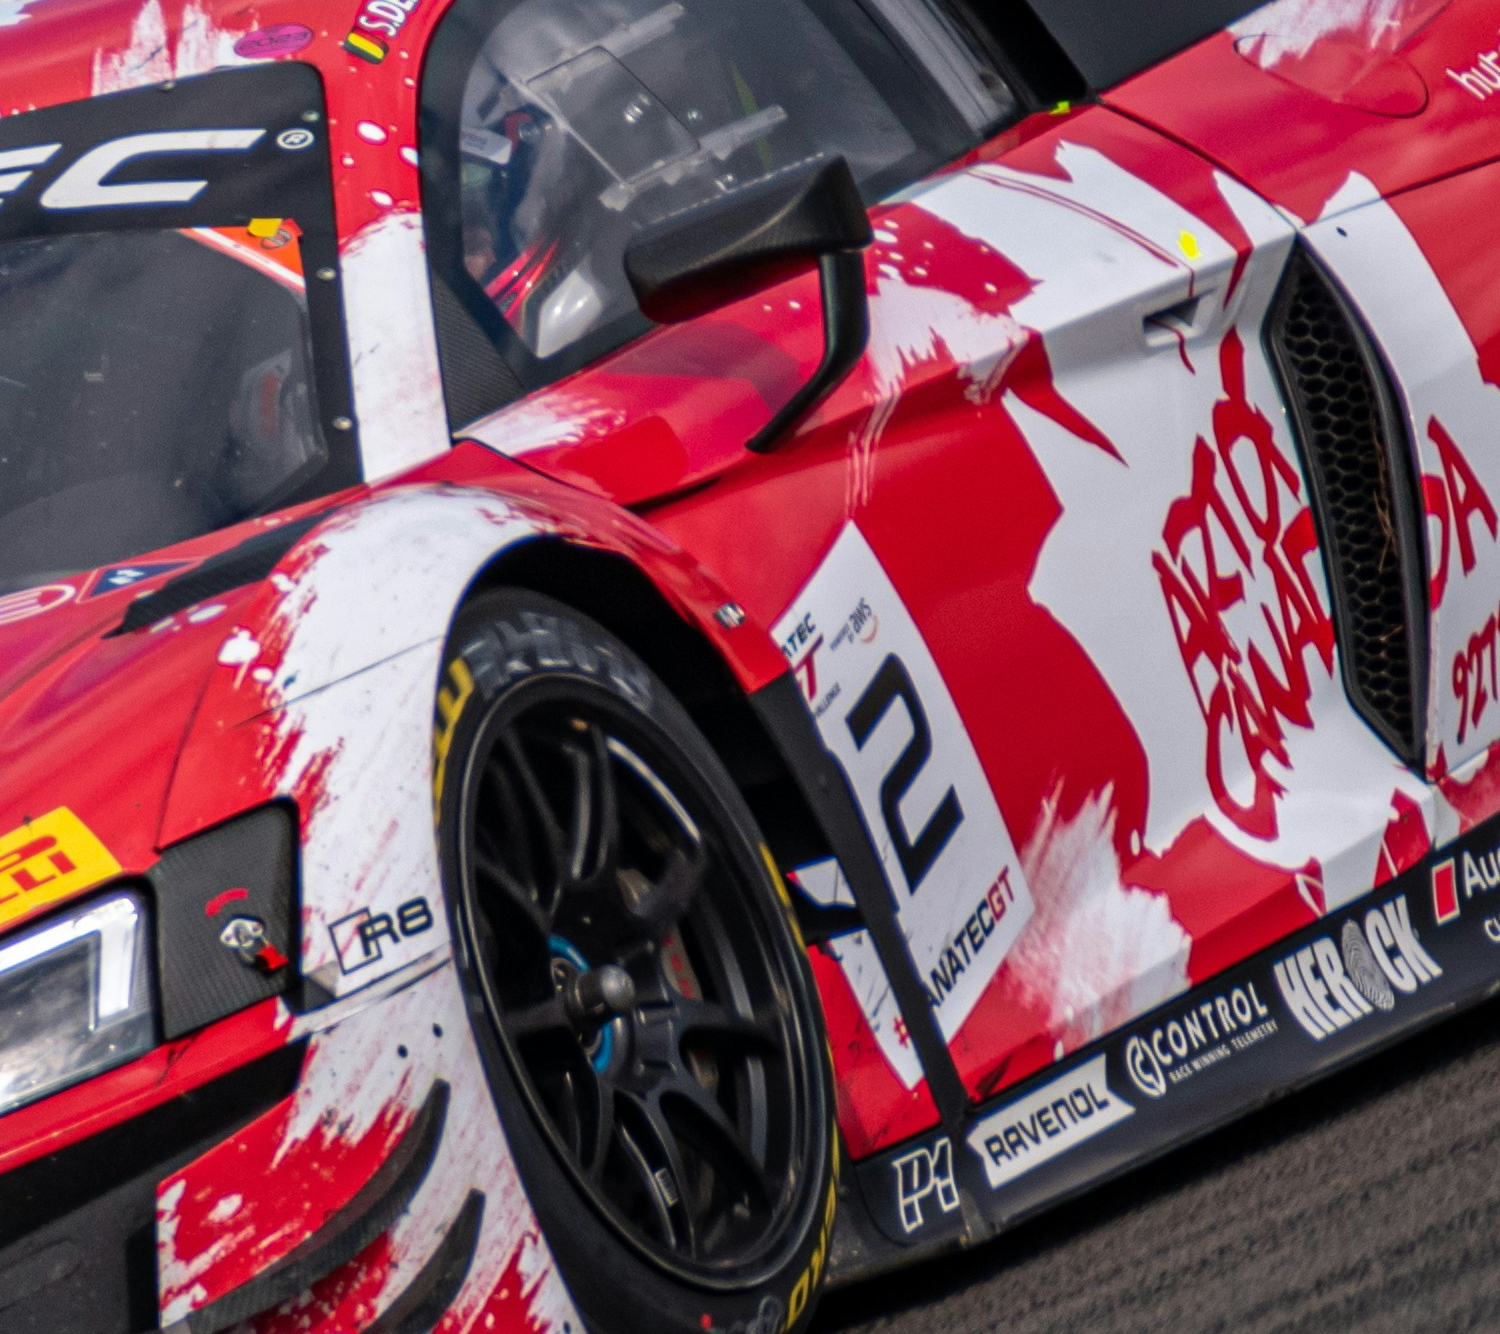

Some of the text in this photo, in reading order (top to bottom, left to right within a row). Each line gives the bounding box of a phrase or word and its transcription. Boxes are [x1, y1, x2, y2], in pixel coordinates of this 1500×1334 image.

[358, 896, 435, 958] R8
[1273, 893, 1444, 1041] HEROCK
[1152, 981, 1269, 1066] CONTROL
